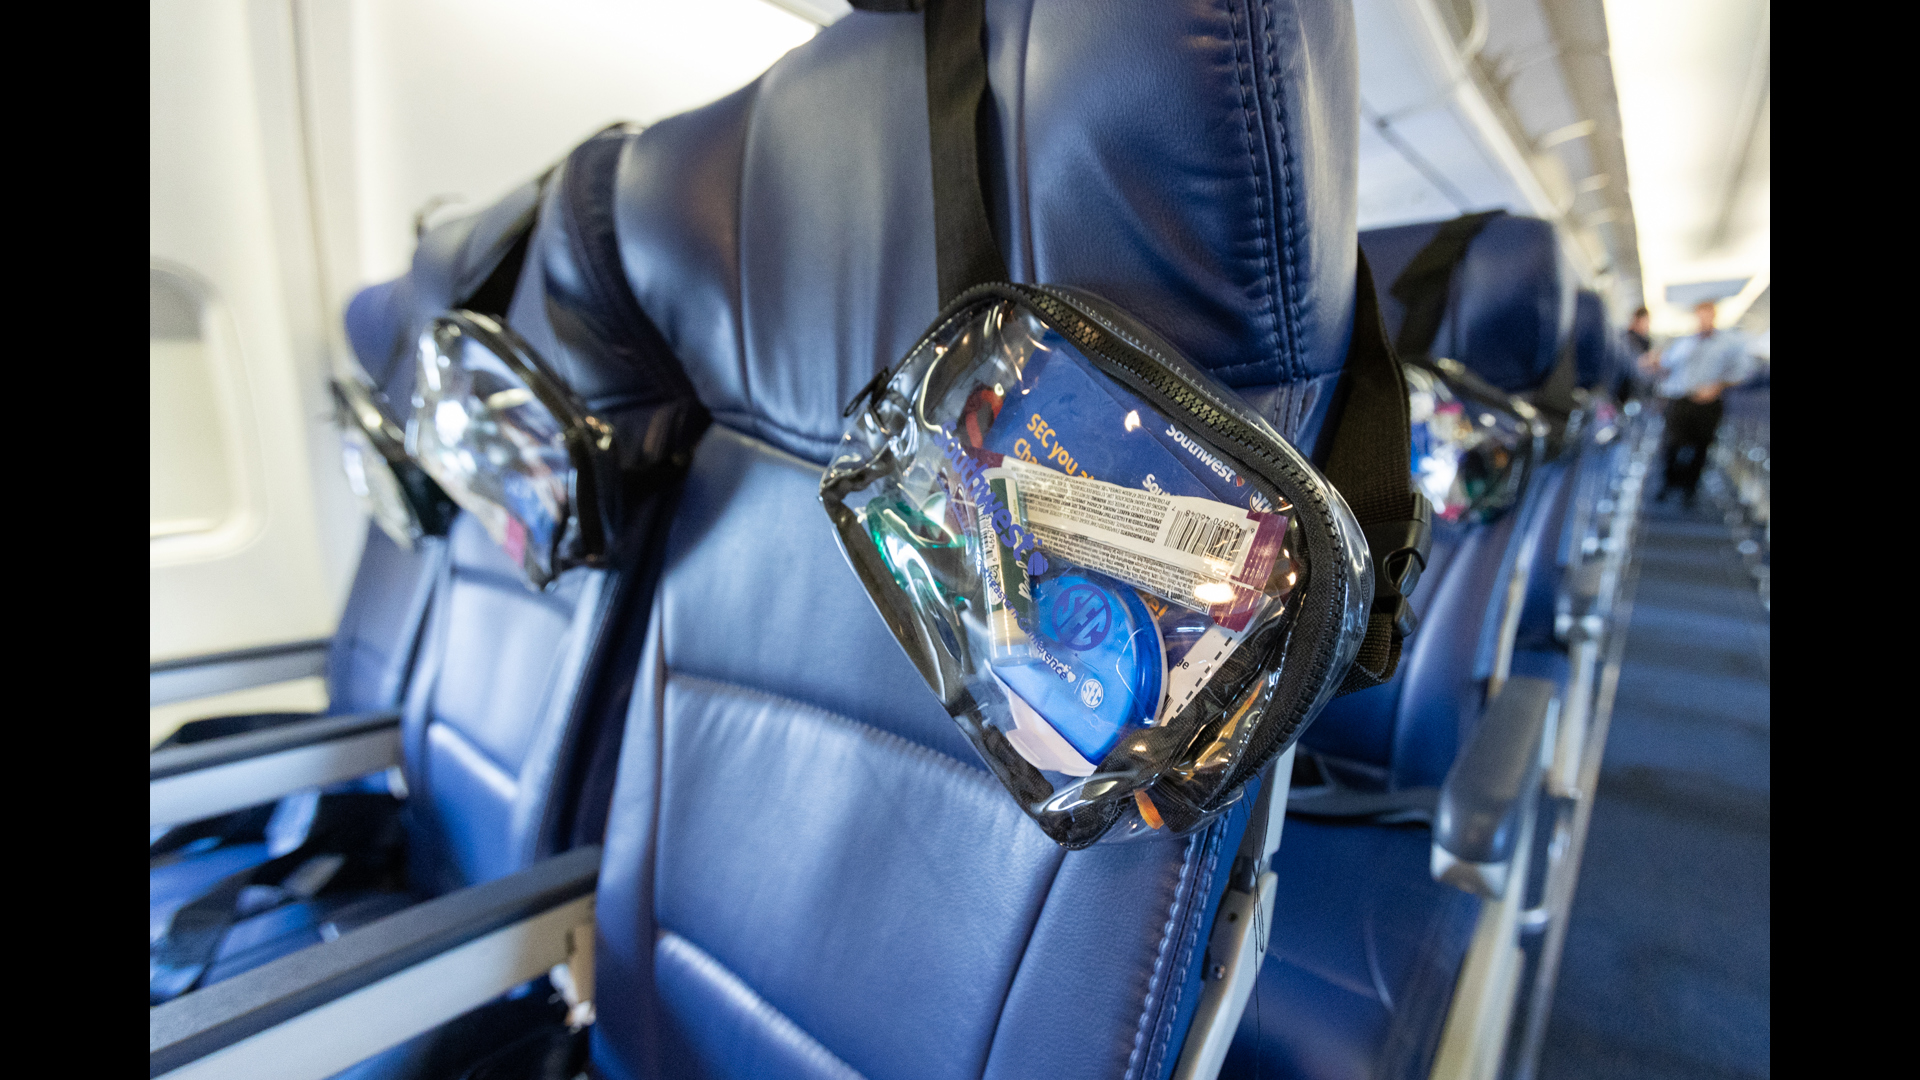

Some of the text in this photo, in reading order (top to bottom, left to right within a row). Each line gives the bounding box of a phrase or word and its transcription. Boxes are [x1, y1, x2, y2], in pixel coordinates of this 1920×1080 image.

[1026, 413, 1056, 448] SEC
[1047, 440, 1078, 475] you
[1165, 424, 1236, 482] Southwest
[933, 421, 1035, 561] Southwest
[1051, 584, 1112, 651] SEC
[1081, 678, 1104, 709] SEC
